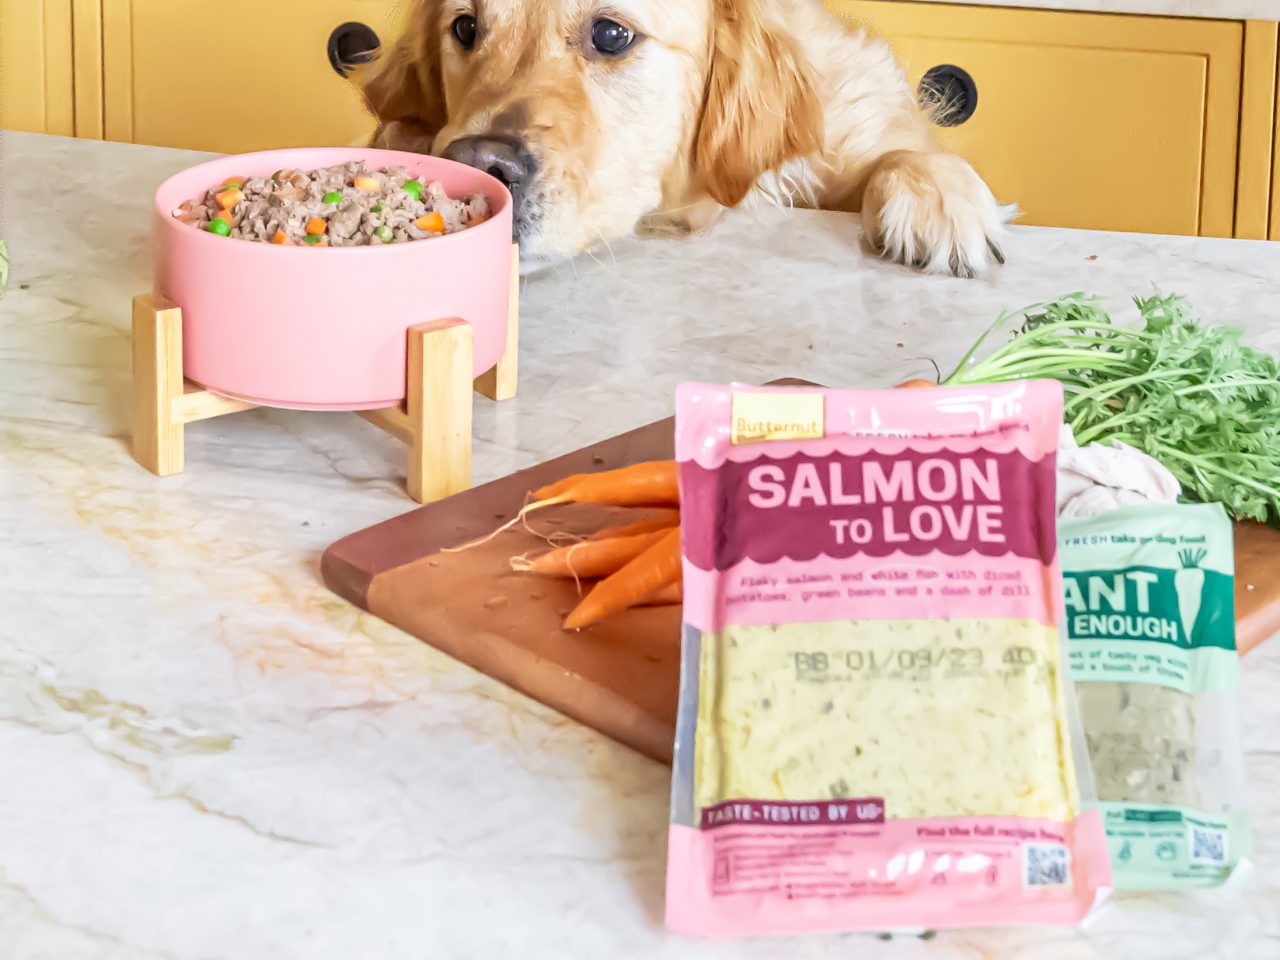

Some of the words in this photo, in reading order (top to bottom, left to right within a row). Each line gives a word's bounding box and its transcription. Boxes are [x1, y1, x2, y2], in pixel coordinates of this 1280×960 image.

[737, 417, 817, 433] Butternut
[748, 458, 1001, 509] SALMON
[830, 519, 873, 545] TO
[882, 505, 1007, 543] LOVE
[741, 576, 778, 586] Flaky
[787, 574, 832, 585] salmon
[841, 572, 863, 581] and
[871, 570, 908, 580] white
[946, 570, 976, 579] with
[801, 589, 839, 602] green
[847, 587, 886, 597] beans
[895, 586, 917, 596] and
[978, 585, 992, 596] of
[1001, 584, 1030, 596] dill
[1063, 571, 1158, 613] ANT
[1074, 614, 1177, 641] ENOUGH
[795, 651, 829, 672] BB
[828, 805, 848, 820] BY
